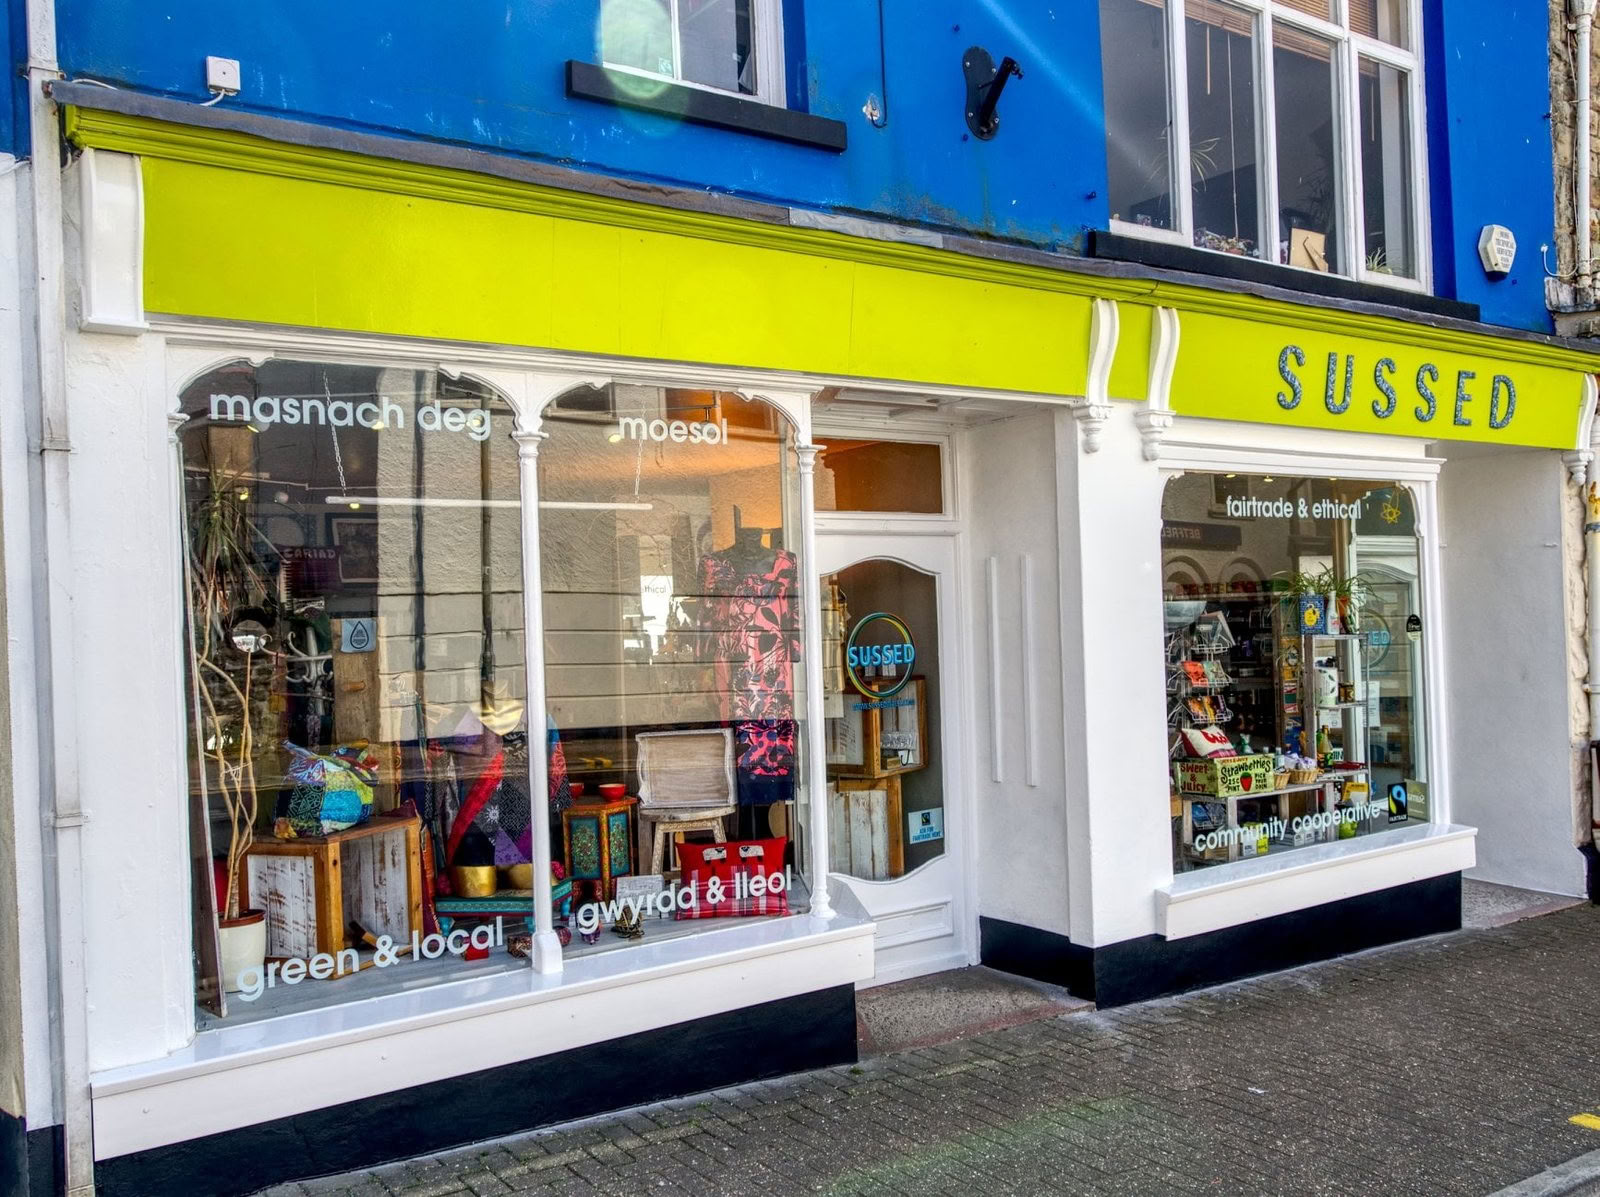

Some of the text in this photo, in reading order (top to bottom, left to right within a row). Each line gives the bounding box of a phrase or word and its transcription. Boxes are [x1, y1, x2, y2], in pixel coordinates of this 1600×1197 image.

[1277, 345, 1516, 429] SUSSED
[209, 393, 491, 441] masnach deg
[619, 417, 728, 445] moesol
[1226, 494, 1361, 519] fairtrade & ethical
[847, 643, 916, 668] SUSSED
[1194, 802, 1381, 852] community cooperative
[577, 880, 697, 935] gwyrdd
[705, 876, 726, 904] &
[735, 864, 792, 900] lleol
[236, 915, 504, 1002] green & local
